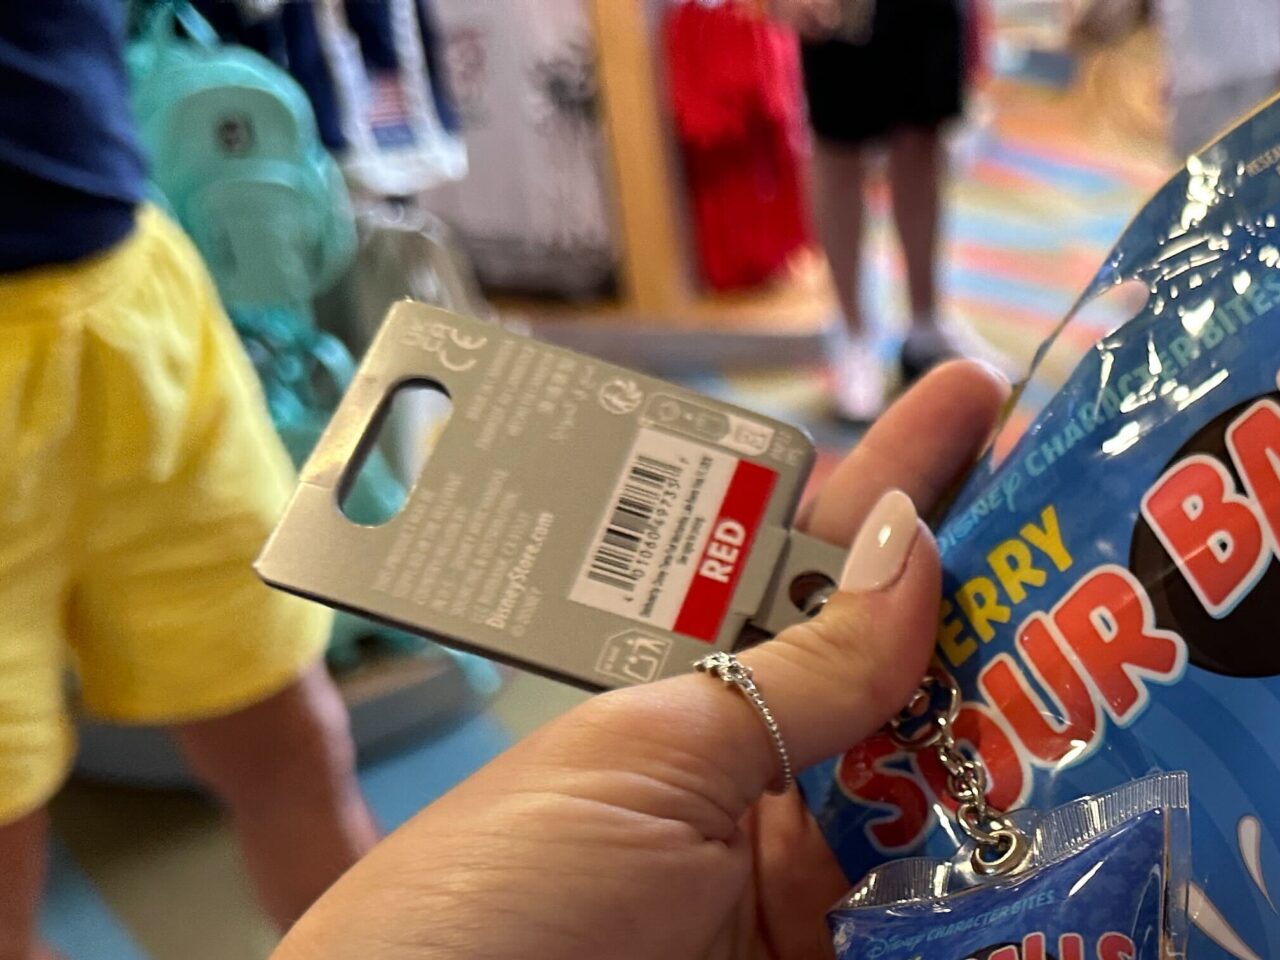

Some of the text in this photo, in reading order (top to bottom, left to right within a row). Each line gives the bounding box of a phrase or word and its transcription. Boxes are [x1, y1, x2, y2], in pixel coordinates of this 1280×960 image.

[488, 511, 555, 630] DisneyStore.com
[700, 518, 747, 585] RED
[930, 505, 1073, 676] ERRY
[836, 564, 1188, 853] SOUR
